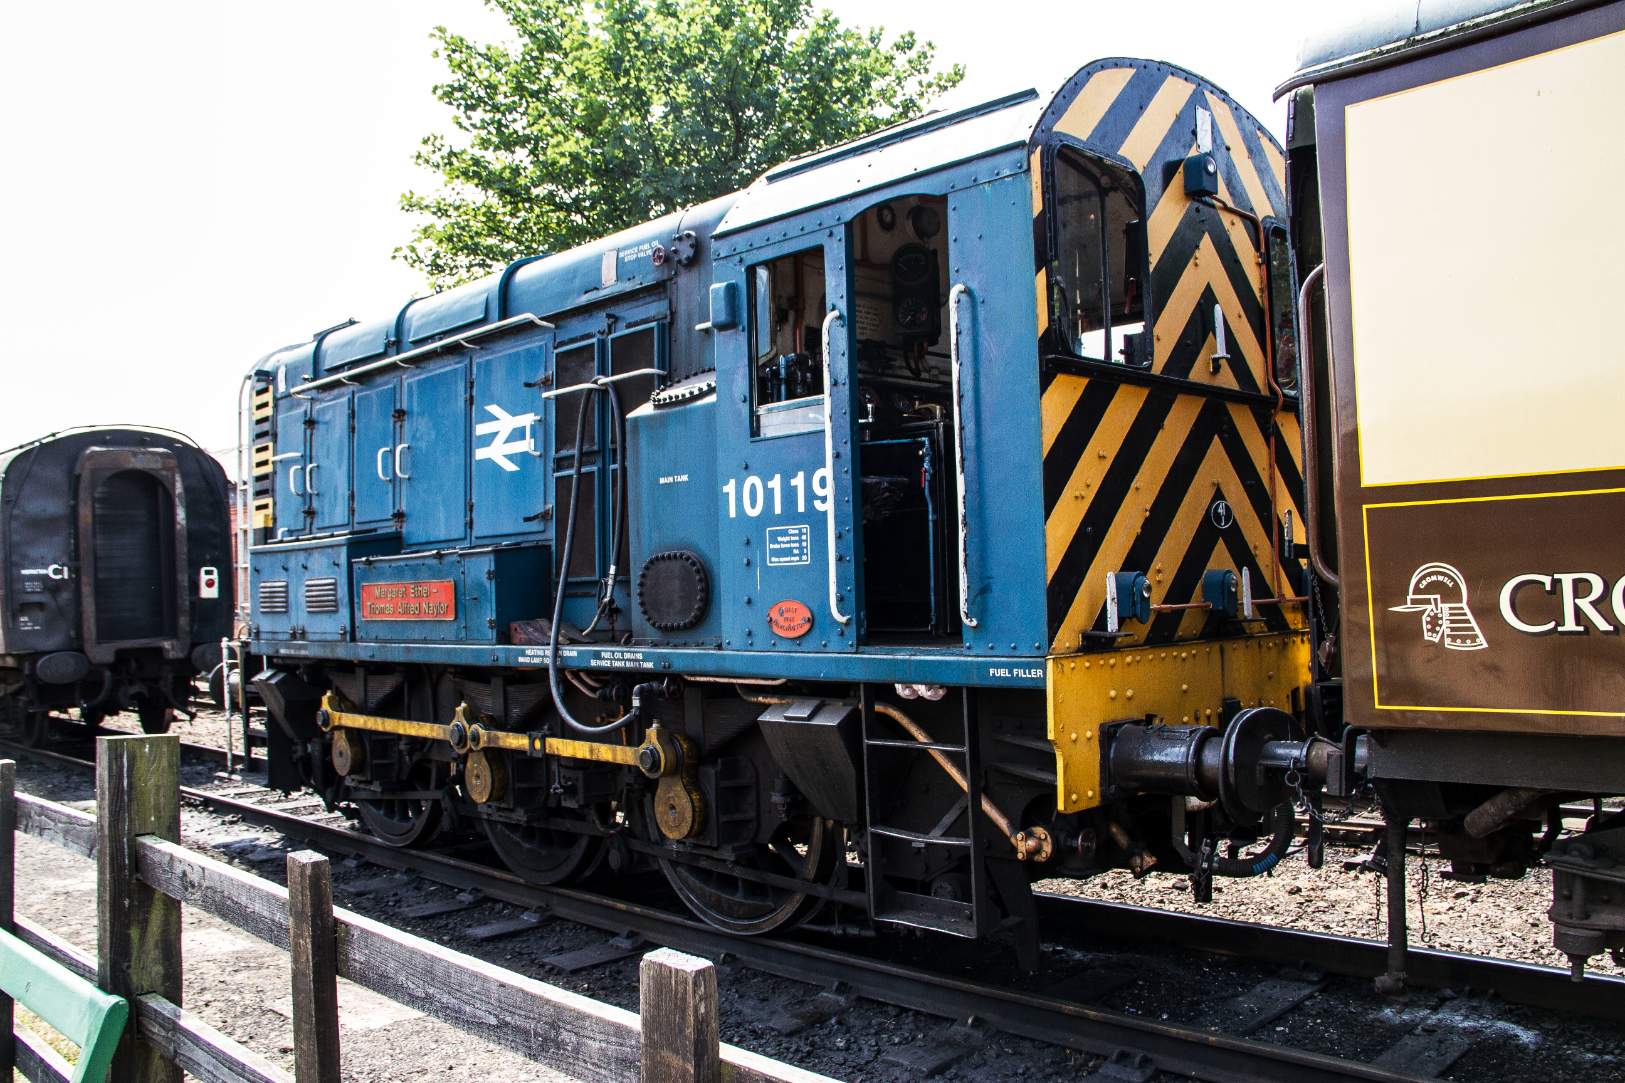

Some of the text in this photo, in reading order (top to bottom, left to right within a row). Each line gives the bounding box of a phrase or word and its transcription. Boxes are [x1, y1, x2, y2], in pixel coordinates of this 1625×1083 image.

[660, 474, 689, 484] MAIN TANK
[722, 467, 832, 519] 10119
[1419, 574, 1455, 589] CROMWELL
[375, 585, 406, 600] Margaret
[410, 584, 430, 598] Ethel
[367, 601, 449, 617] Thomas Alfred Naylor
[1499, 572, 1625, 634] CR
[601, 651, 643, 660] FUEL OIL DRAINS
[590, 659, 611, 667] SERVICE
[612, 660, 625, 668] TANK
[640, 661, 654, 669] TANK
[989, 668, 1044, 679] FUEL FILLER
